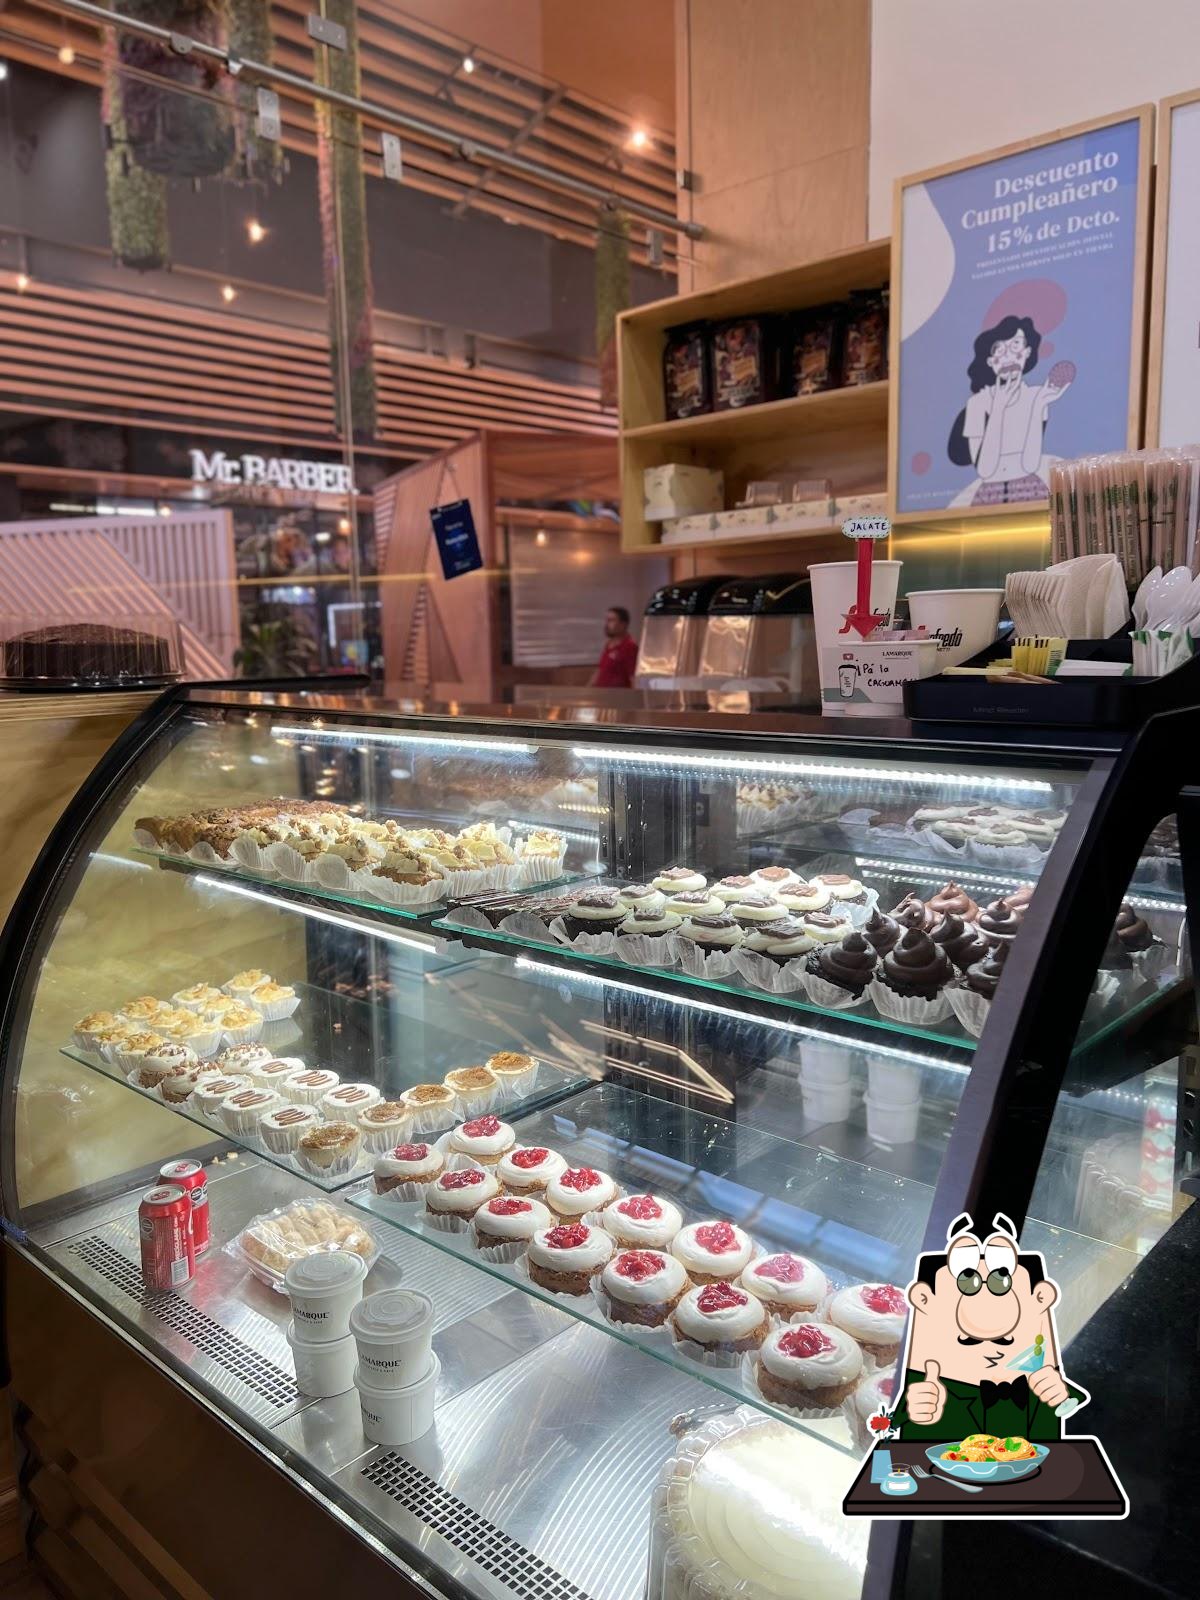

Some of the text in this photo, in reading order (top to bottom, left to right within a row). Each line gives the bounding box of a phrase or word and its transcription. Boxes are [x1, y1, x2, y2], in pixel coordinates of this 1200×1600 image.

[994, 151, 1119, 198] Descuento
[961, 176, 1118, 229] Cumpleañero
[987, 225, 1033, 253] 15%
[1035, 221, 1061, 241] de
[1067, 210, 1120, 234] Dcto.
